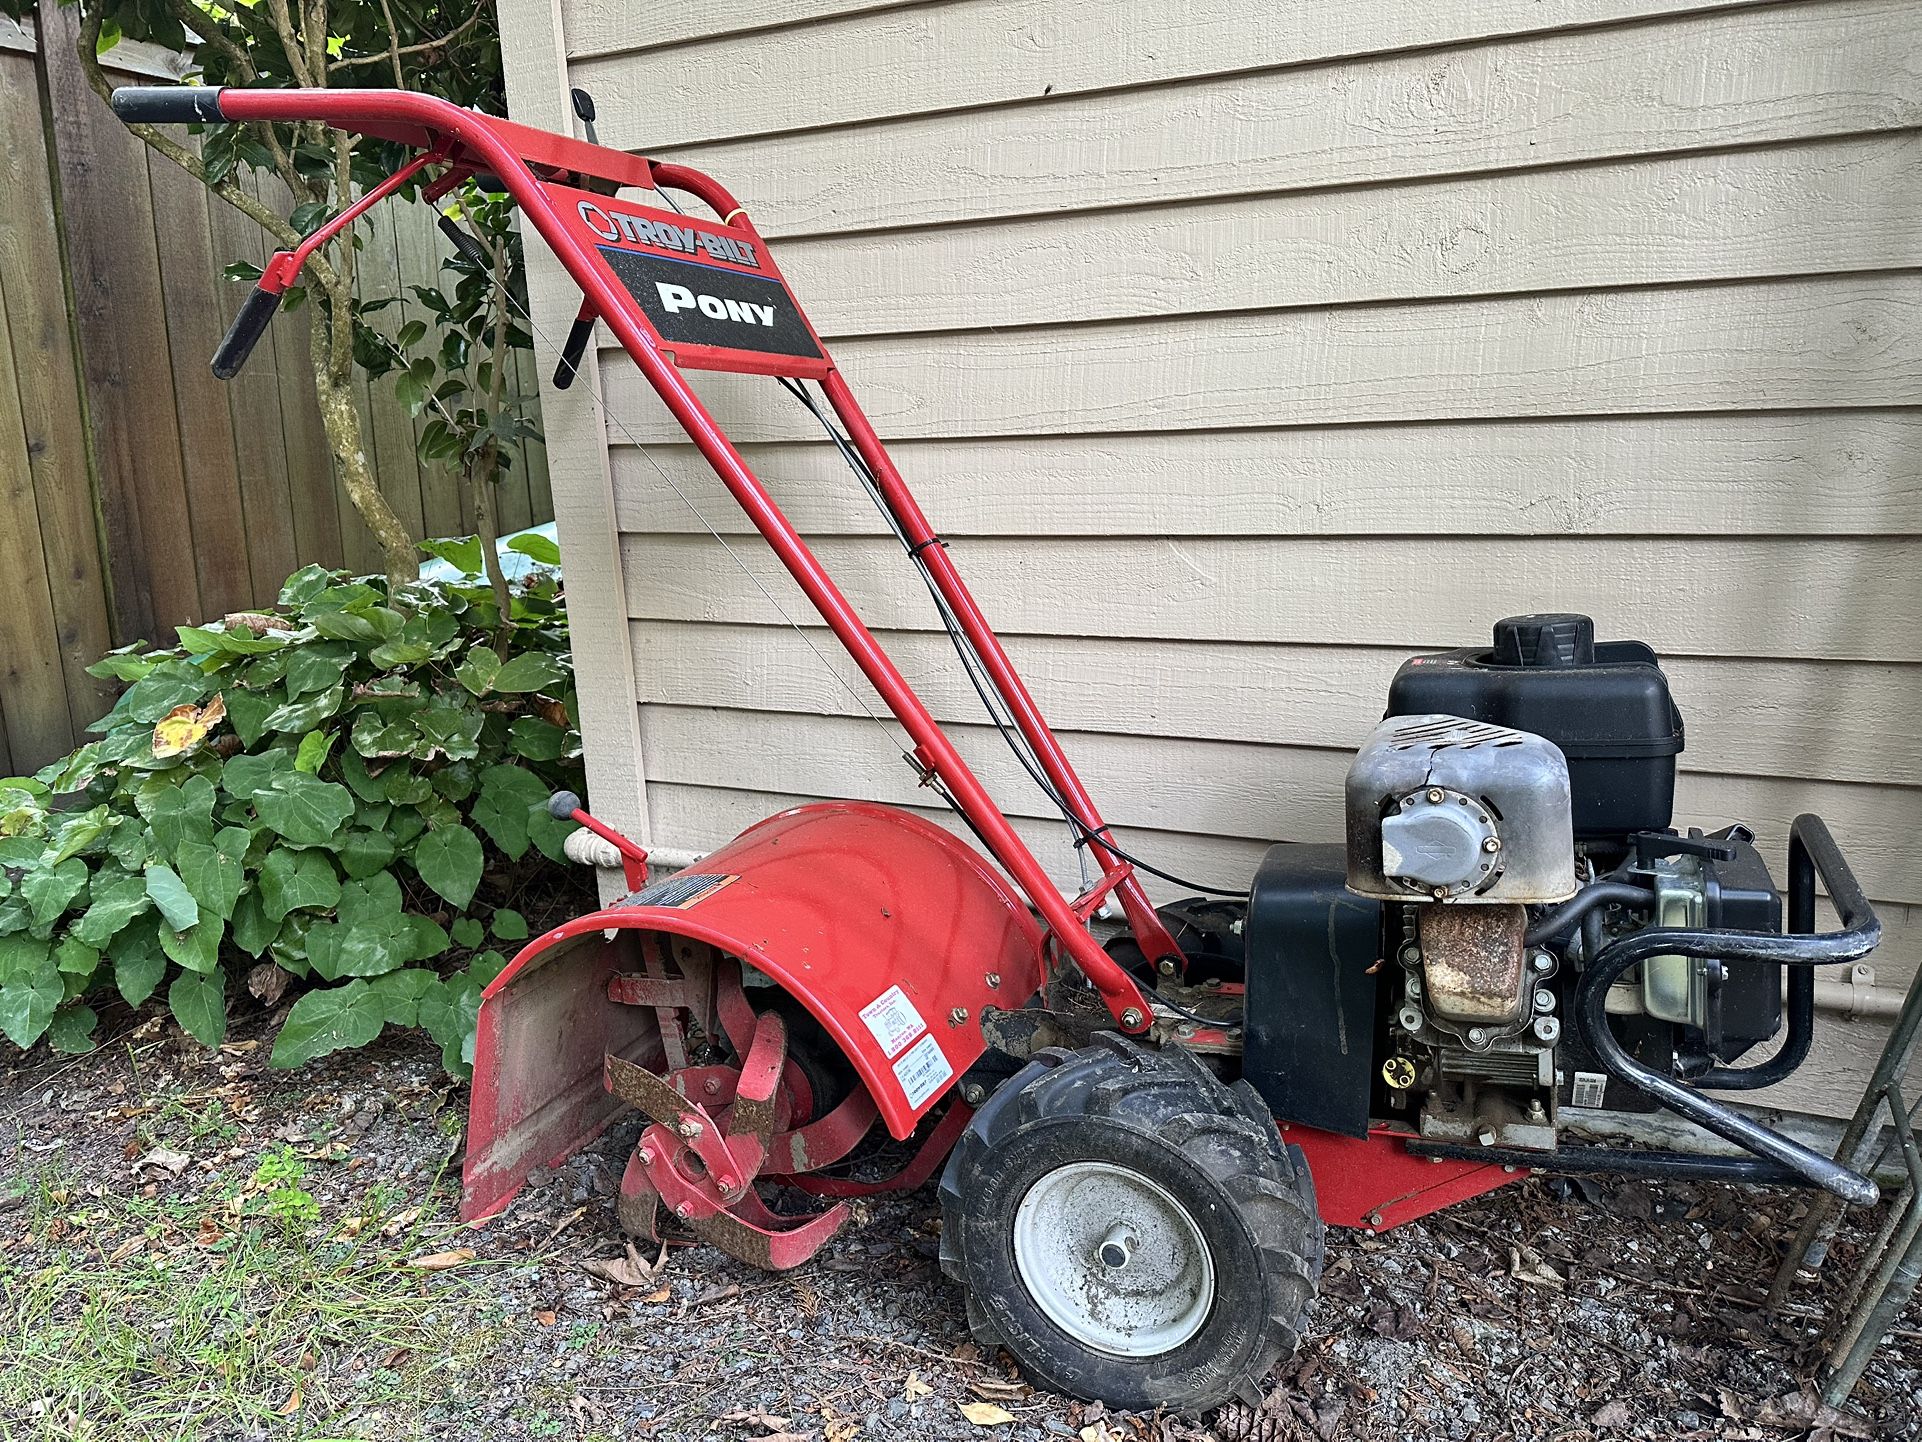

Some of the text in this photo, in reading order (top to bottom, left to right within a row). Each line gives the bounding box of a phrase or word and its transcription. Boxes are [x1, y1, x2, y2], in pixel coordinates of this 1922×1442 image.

[609, 210, 761, 268] TROY-BILT
[861, 1007, 877, 1019] Town
[880, 989, 900, 1006] Country
[988, 1292, 1084, 1382] CARLISLE
